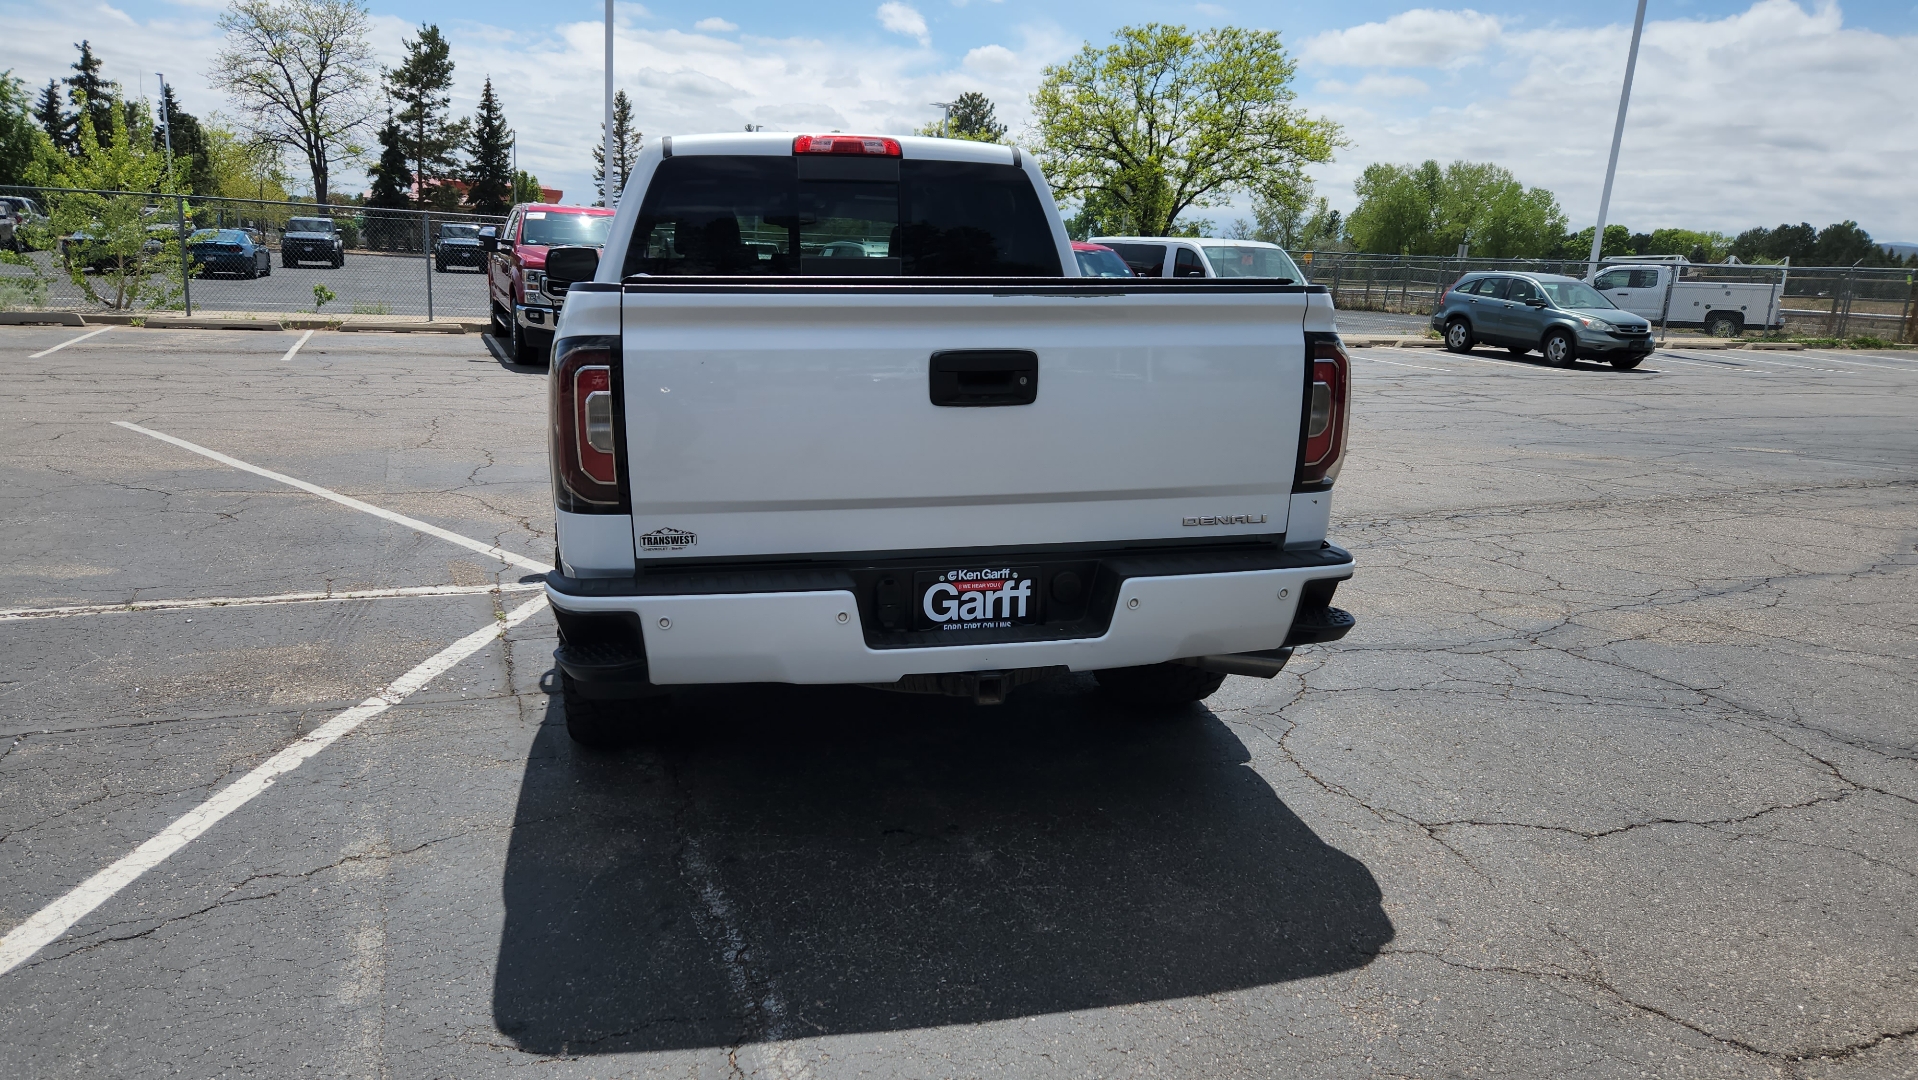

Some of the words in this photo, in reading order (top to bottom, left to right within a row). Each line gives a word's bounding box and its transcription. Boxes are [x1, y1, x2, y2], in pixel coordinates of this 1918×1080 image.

[1182, 513, 1268, 527] DENALI
[641, 534, 695, 546] TRANSWEST
[958, 569, 981, 581] Ken
[981, 568, 1010, 580] Garff
[923, 579, 1031, 623] Garff
